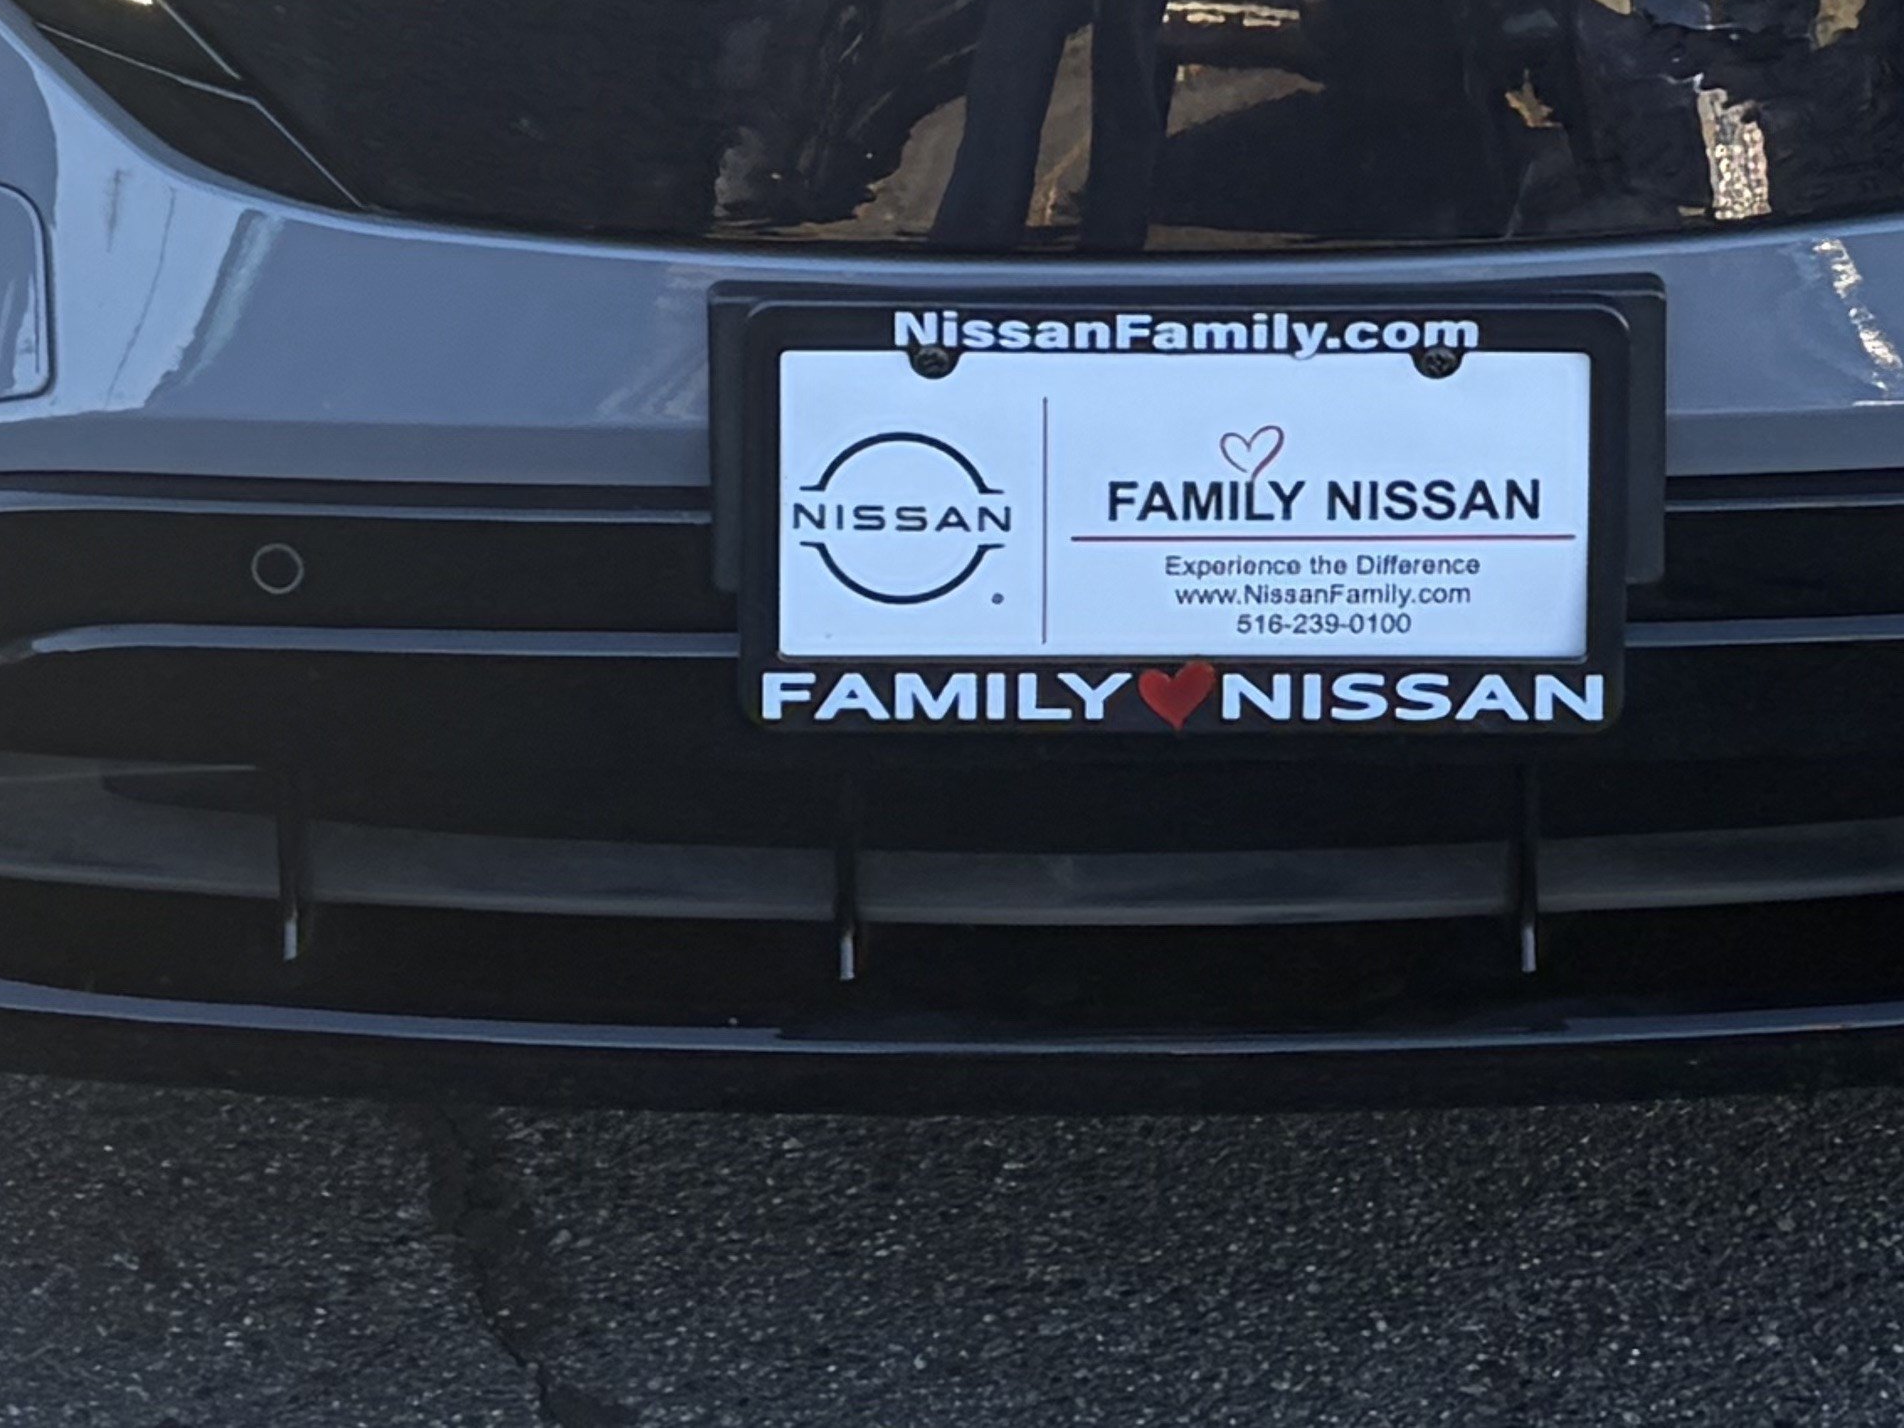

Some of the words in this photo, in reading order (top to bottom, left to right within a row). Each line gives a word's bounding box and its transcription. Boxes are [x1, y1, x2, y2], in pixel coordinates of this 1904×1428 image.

[895, 312, 1478, 358] NissanFamily.com
[1107, 479, 1306, 522] FAMILY
[1327, 479, 1542, 522] NISSAN
[793, 503, 1012, 533] NISSAN
[1165, 555, 1301, 580] Experience
[1308, 555, 1347, 576] the
[1356, 554, 1480, 576] Difference
[1175, 582, 1472, 607] www.NissanFamily.com
[1236, 612, 1412, 636] 516-239-0100
[761, 672, 1132, 721] FAMILY
[1222, 672, 1605, 721] NISSAN
